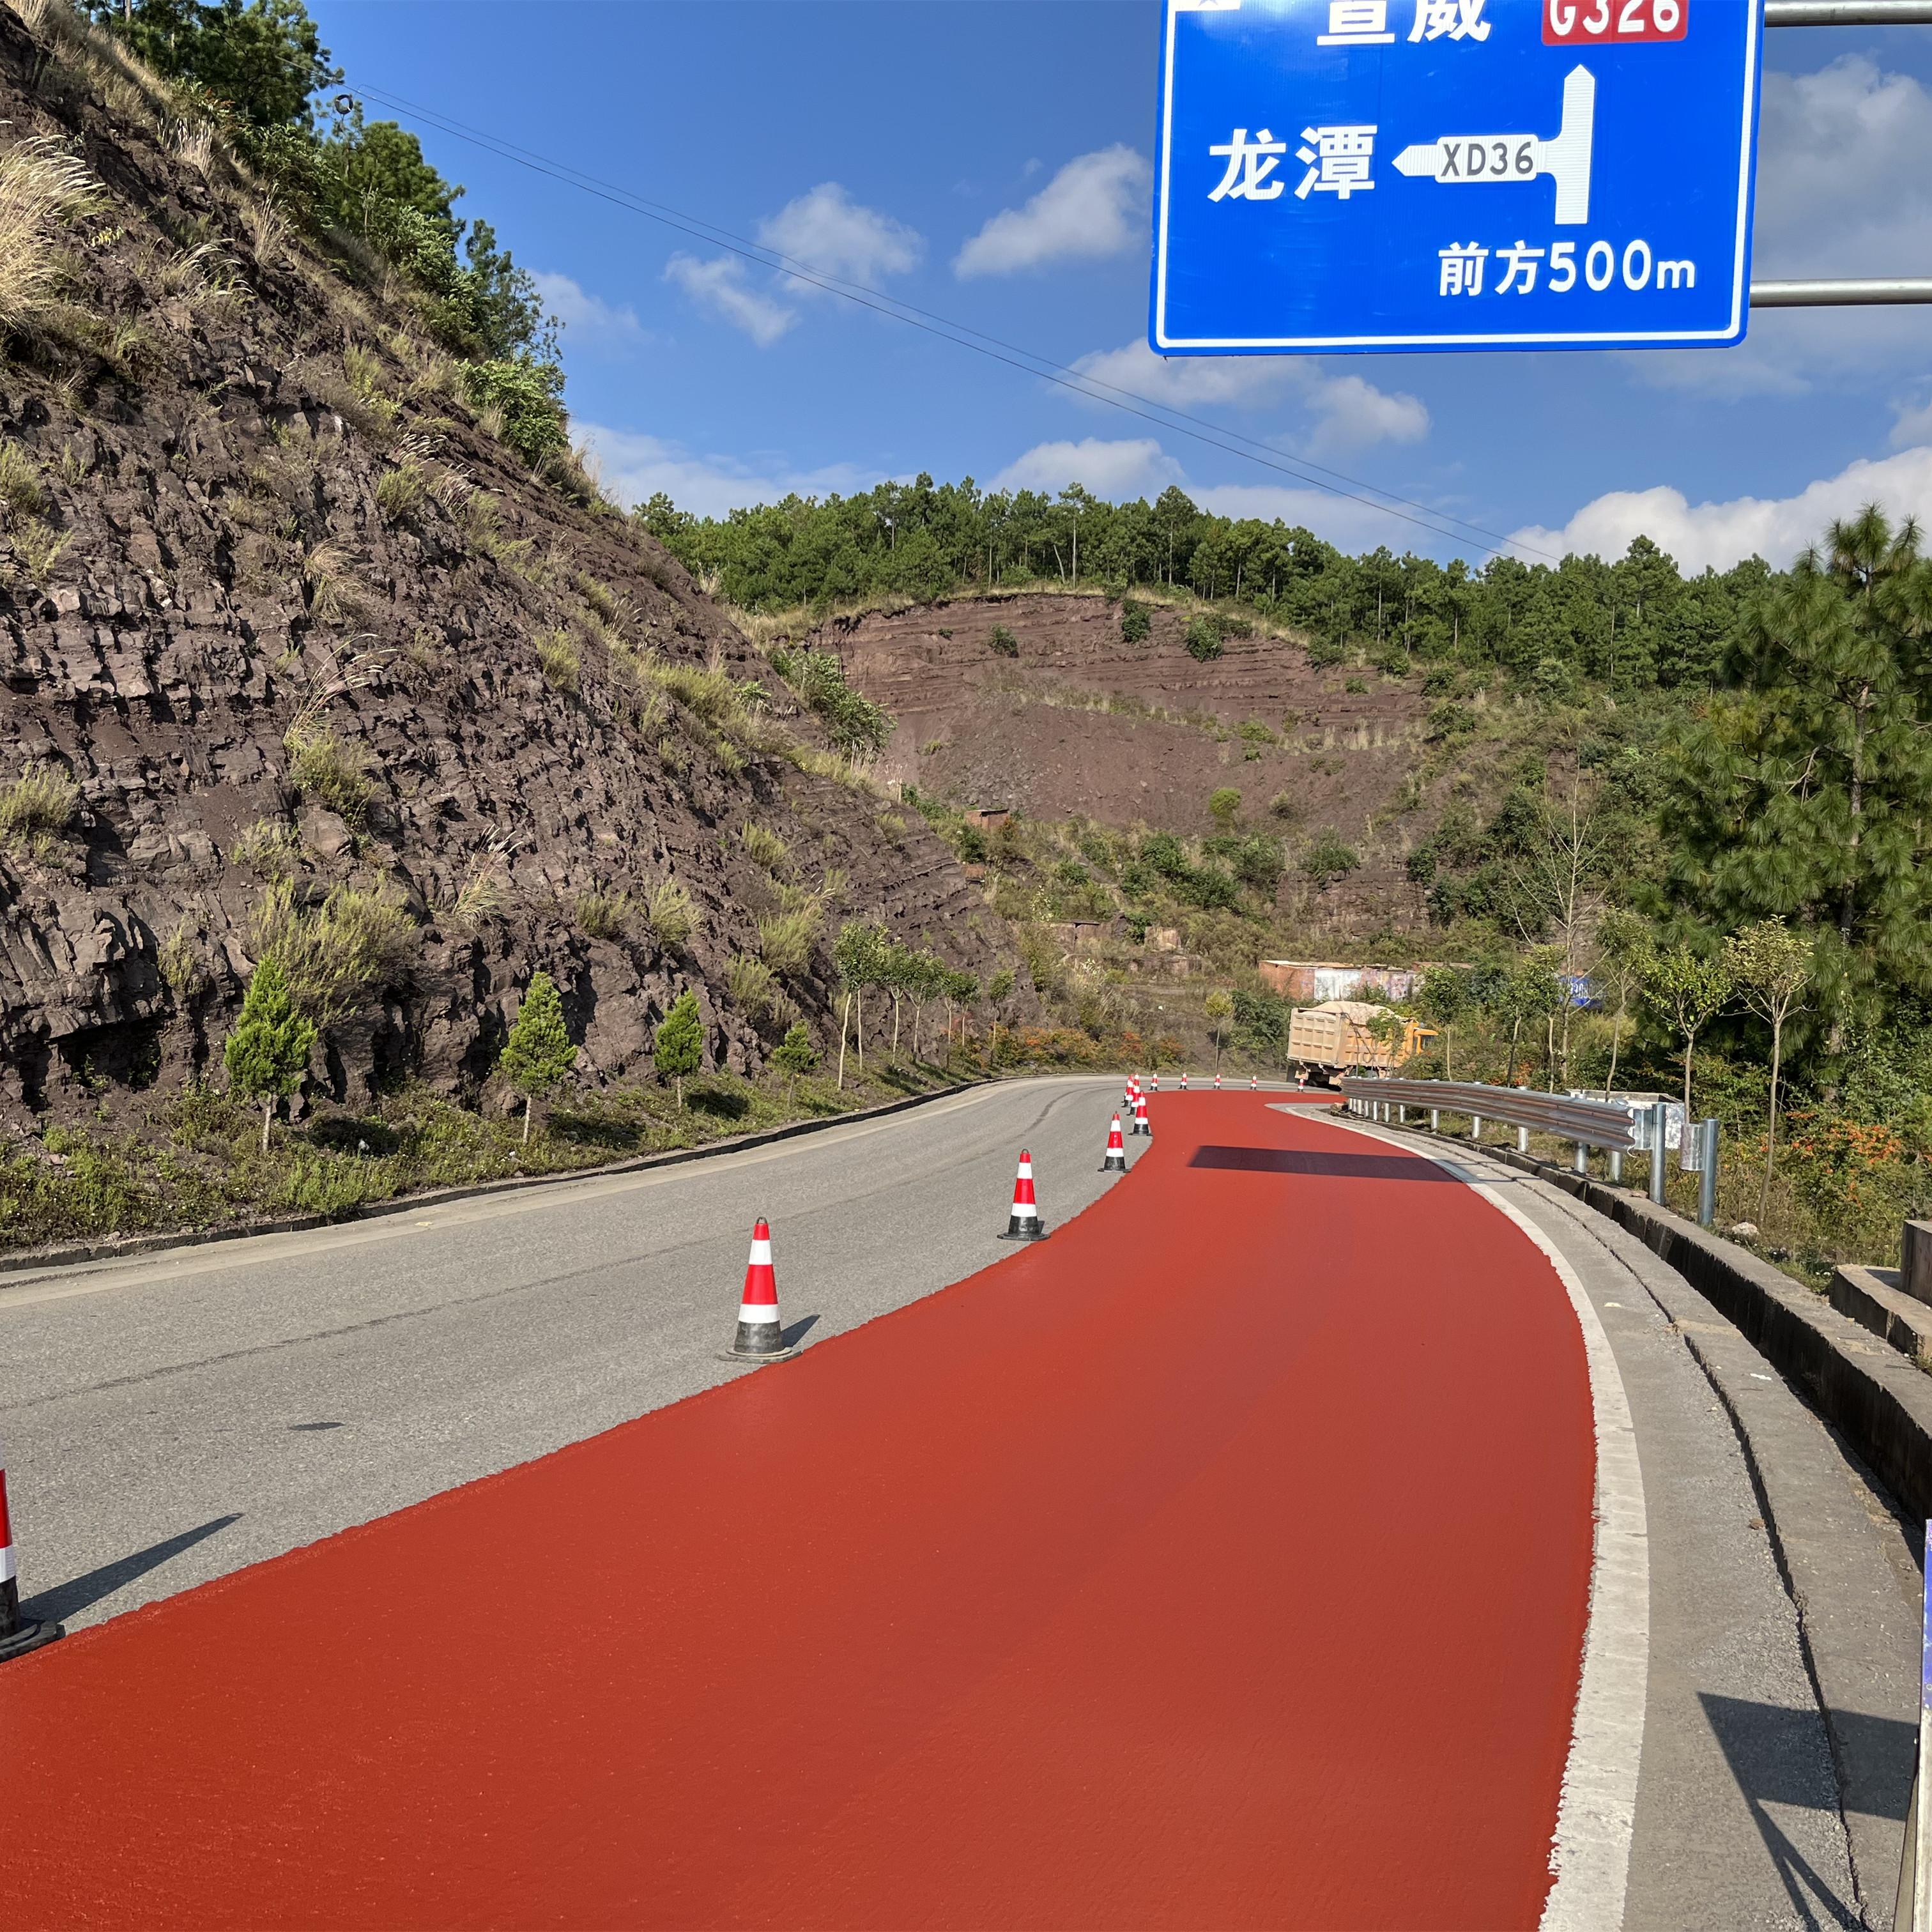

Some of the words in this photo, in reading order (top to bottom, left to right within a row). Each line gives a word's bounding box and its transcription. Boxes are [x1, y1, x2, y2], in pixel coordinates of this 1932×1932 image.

[1549, 0, 1680, 36] G326
[1207, 125, 1377, 203] 龙潭
[1441, 142, 1533, 177] XD36
[1438, 239, 1696, 296] 前方500m
